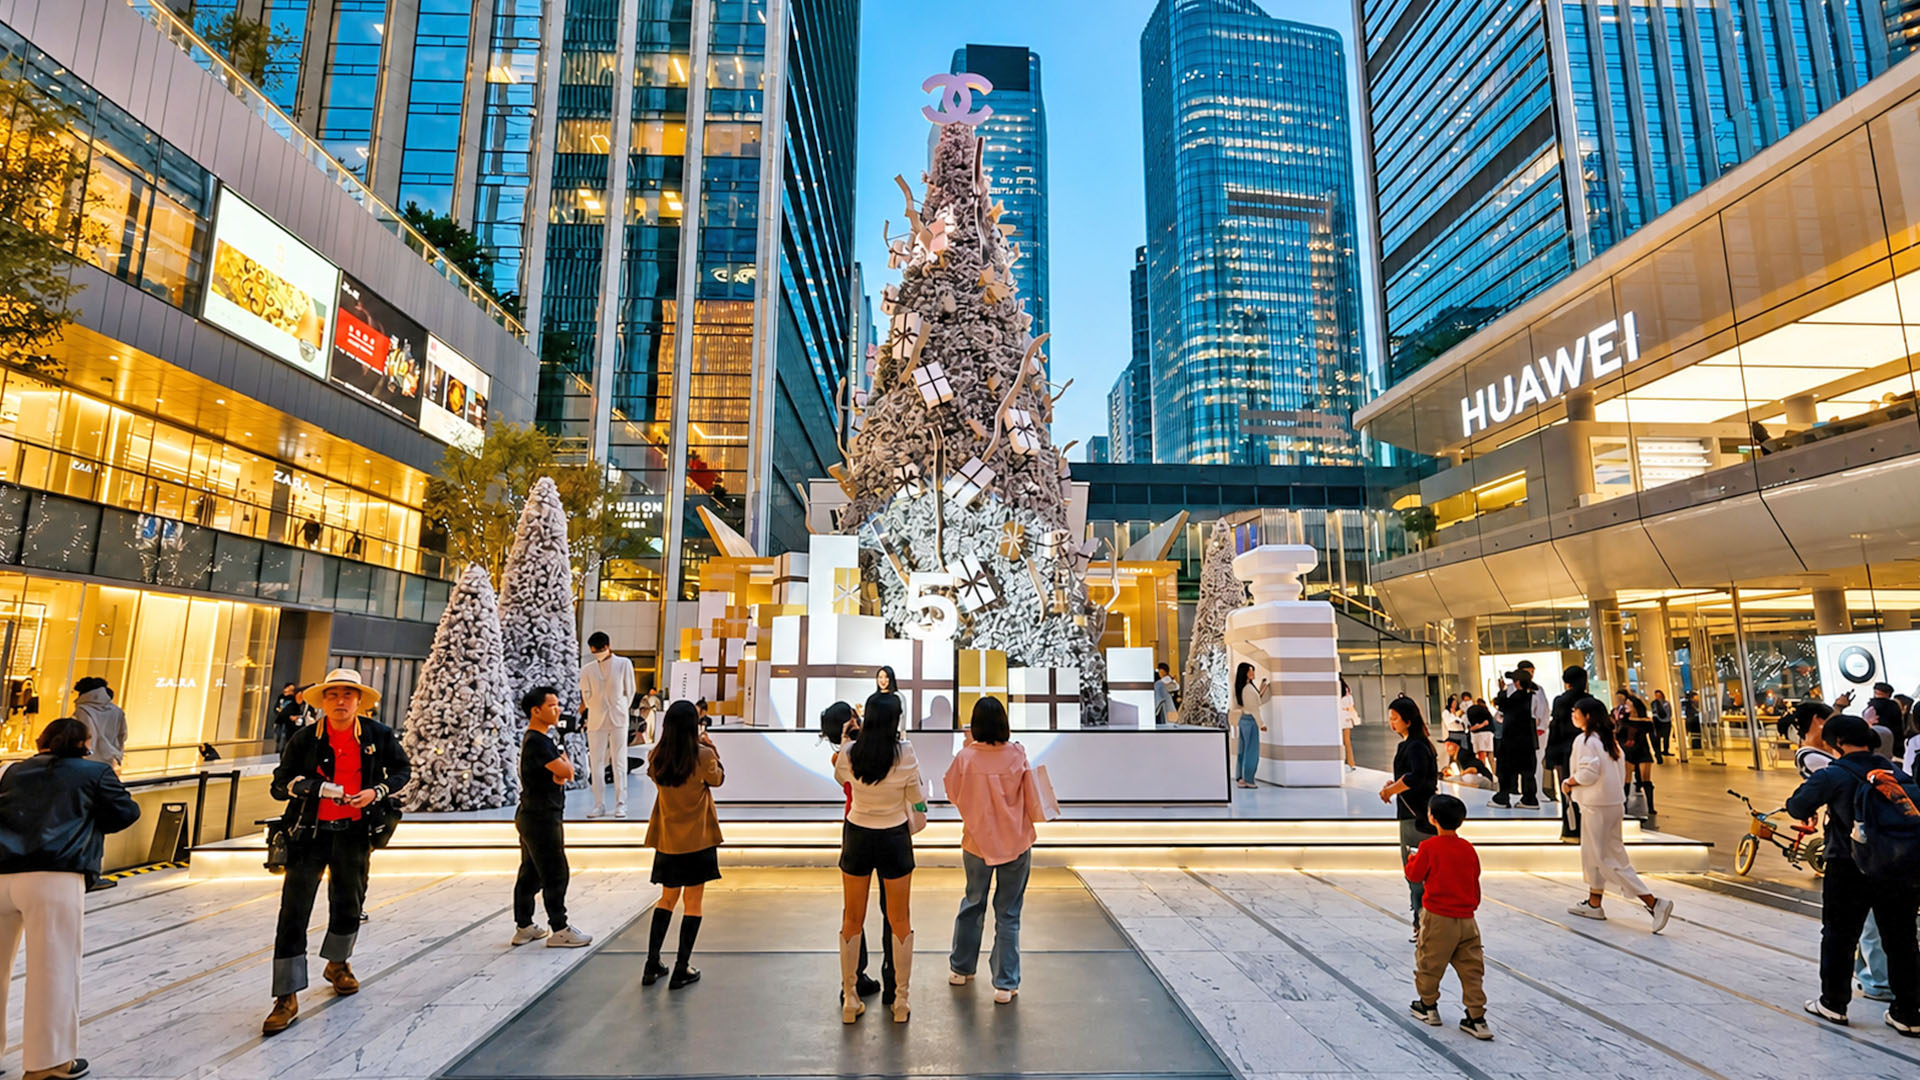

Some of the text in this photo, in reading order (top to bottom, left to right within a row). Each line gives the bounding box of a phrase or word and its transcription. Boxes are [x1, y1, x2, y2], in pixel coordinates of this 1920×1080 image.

[1461, 311, 1640, 438] HUAWEI
[273, 470, 312, 492] ZARA
[608, 502, 663, 512] FUSION
[903, 572, 958, 642] 5
[155, 677, 197, 688] ZARA
